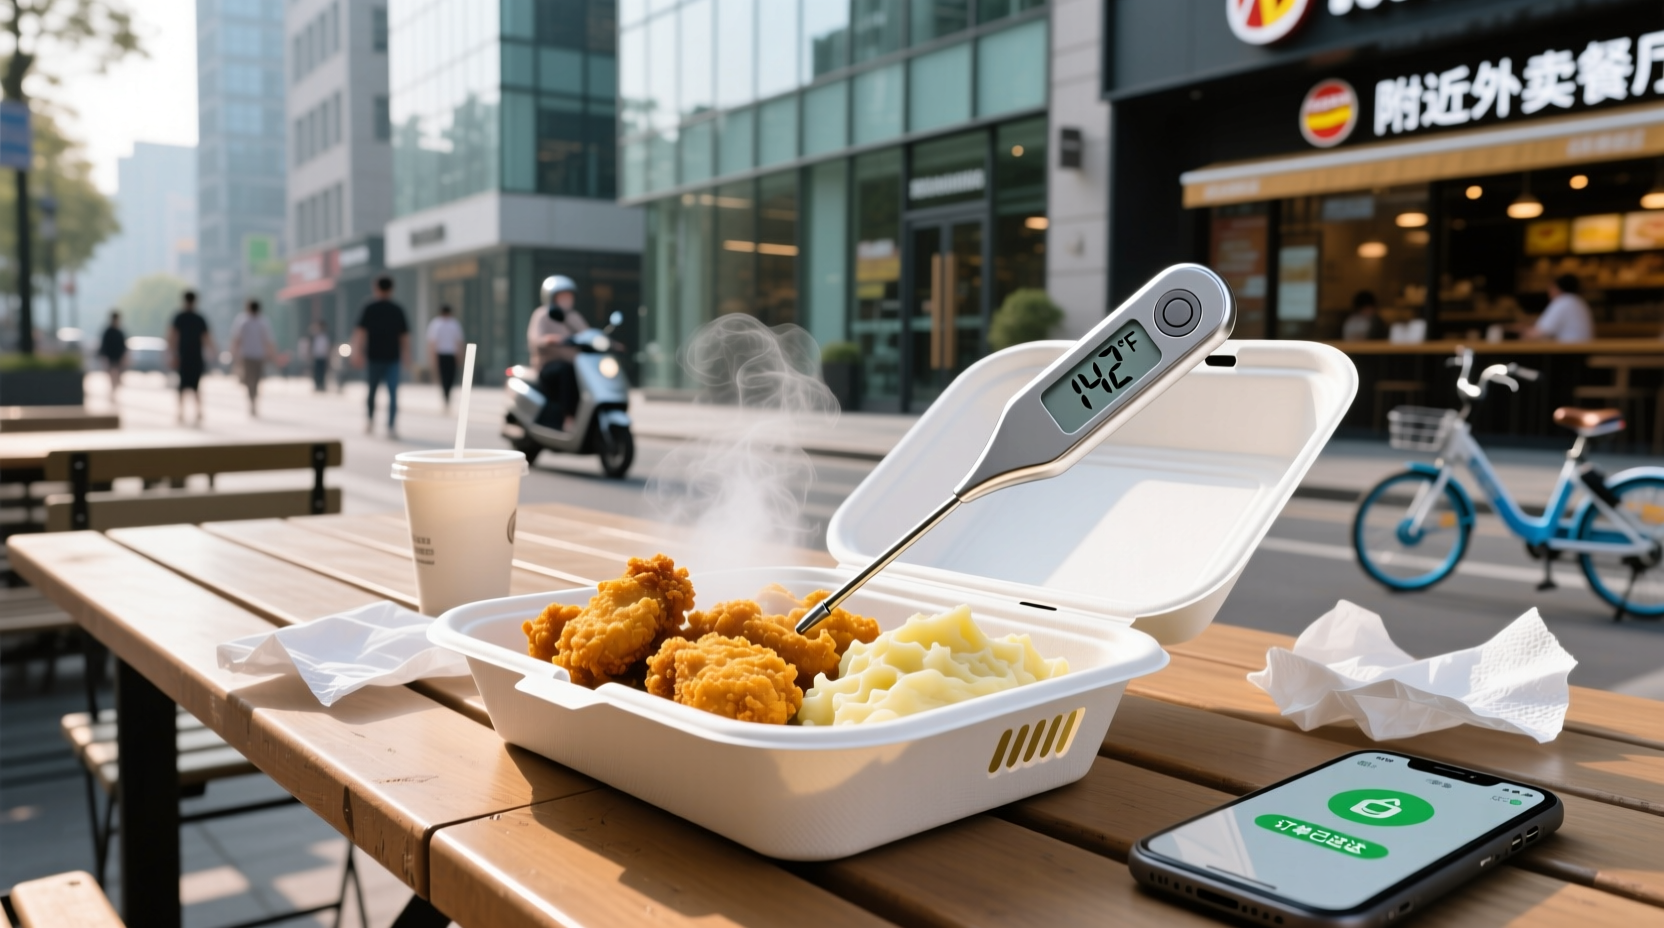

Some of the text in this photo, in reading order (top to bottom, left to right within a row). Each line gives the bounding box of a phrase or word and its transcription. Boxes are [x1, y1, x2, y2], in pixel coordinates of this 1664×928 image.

[1374, 31, 1664, 136] 附近外卖餐厅
